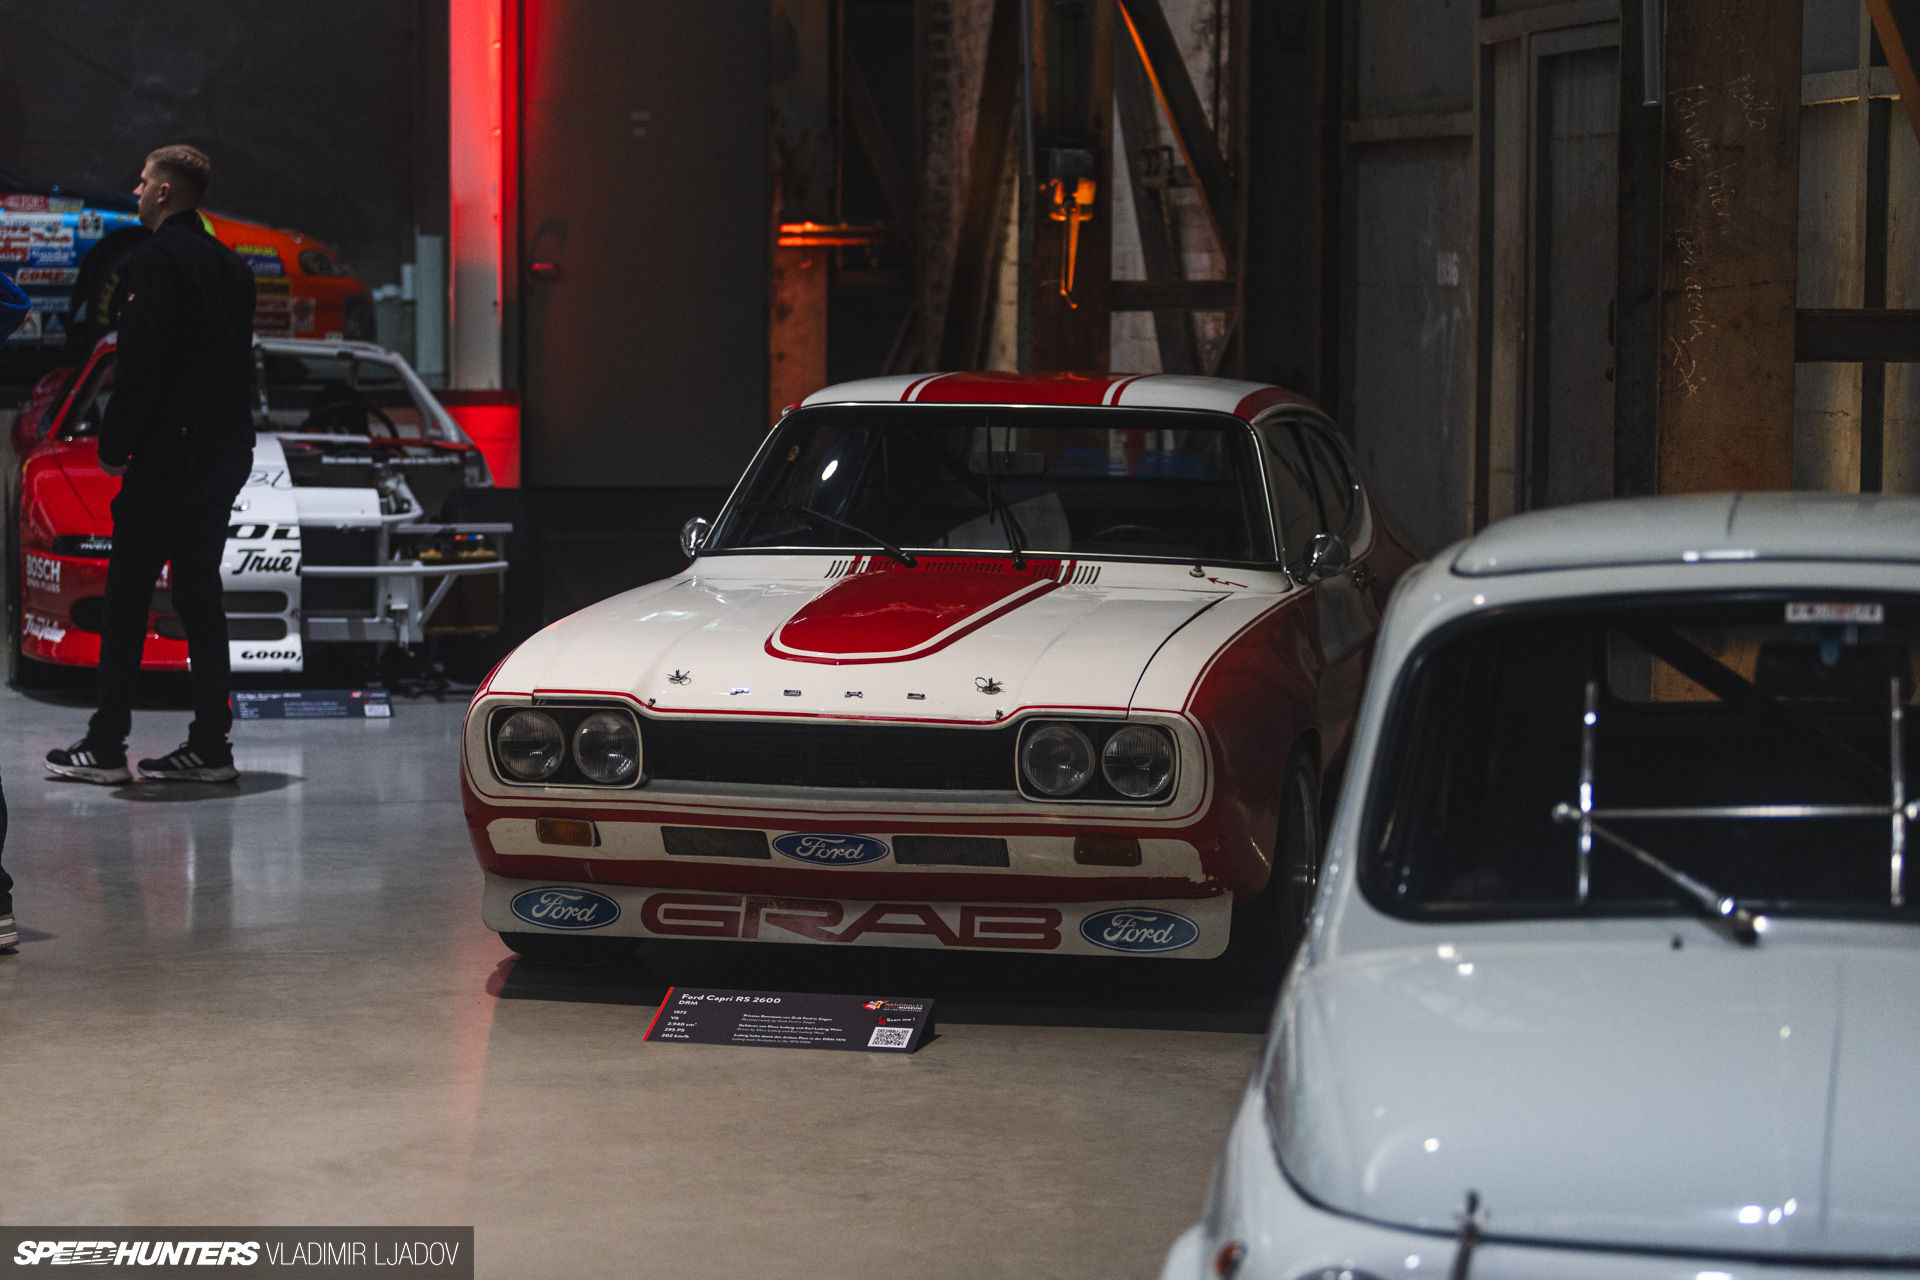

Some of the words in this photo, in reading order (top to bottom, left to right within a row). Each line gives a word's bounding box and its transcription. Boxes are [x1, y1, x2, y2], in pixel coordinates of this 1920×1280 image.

[228, 524, 300, 540] OD
[27, 554, 61, 582] BOSCH
[231, 549, 293, 575] True
[797, 834, 866, 861] Ford
[548, 890, 602, 924] Ford
[640, 893, 1062, 950] GRAB
[1102, 911, 1174, 946] Ford
